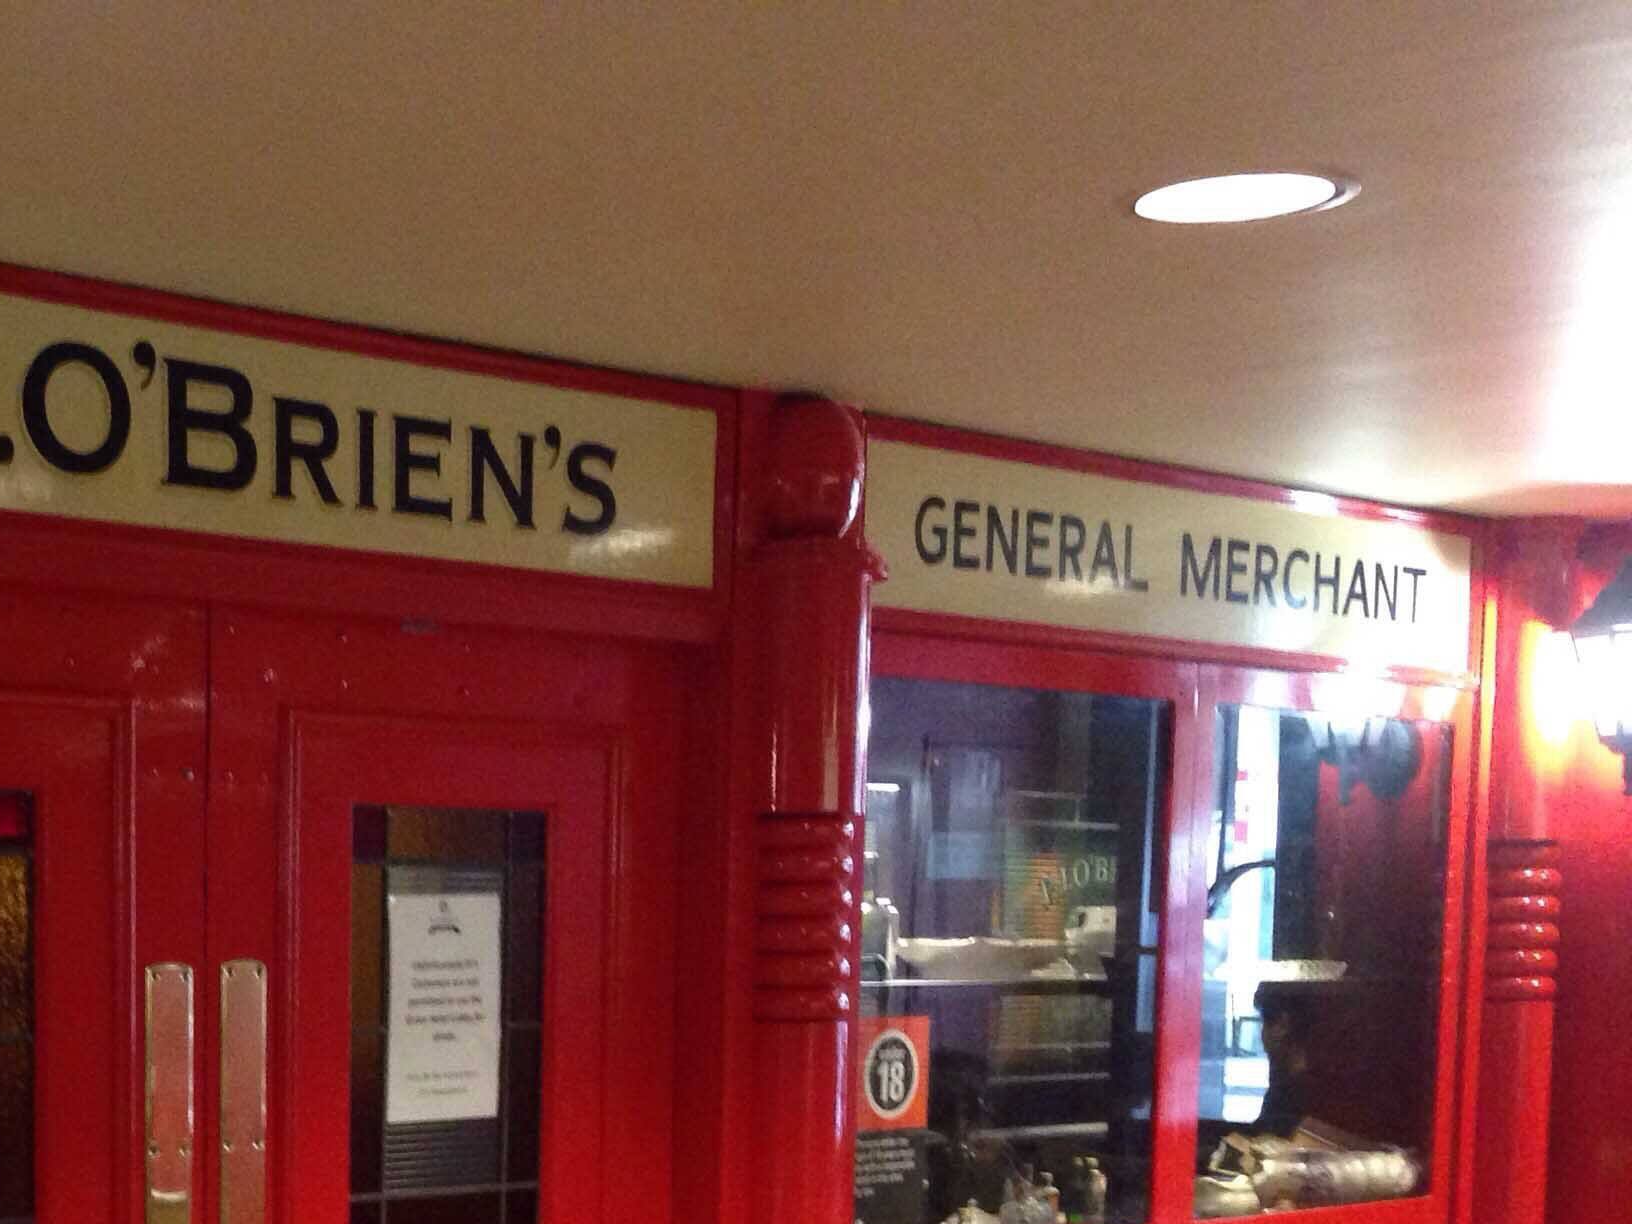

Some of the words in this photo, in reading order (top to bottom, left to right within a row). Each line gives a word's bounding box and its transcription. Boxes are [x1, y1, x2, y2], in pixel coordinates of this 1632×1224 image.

[913, 496, 1149, 593] GENERAL
[1178, 531, 1428, 624] MERCHANT
[878, 1060, 906, 1103] 18
